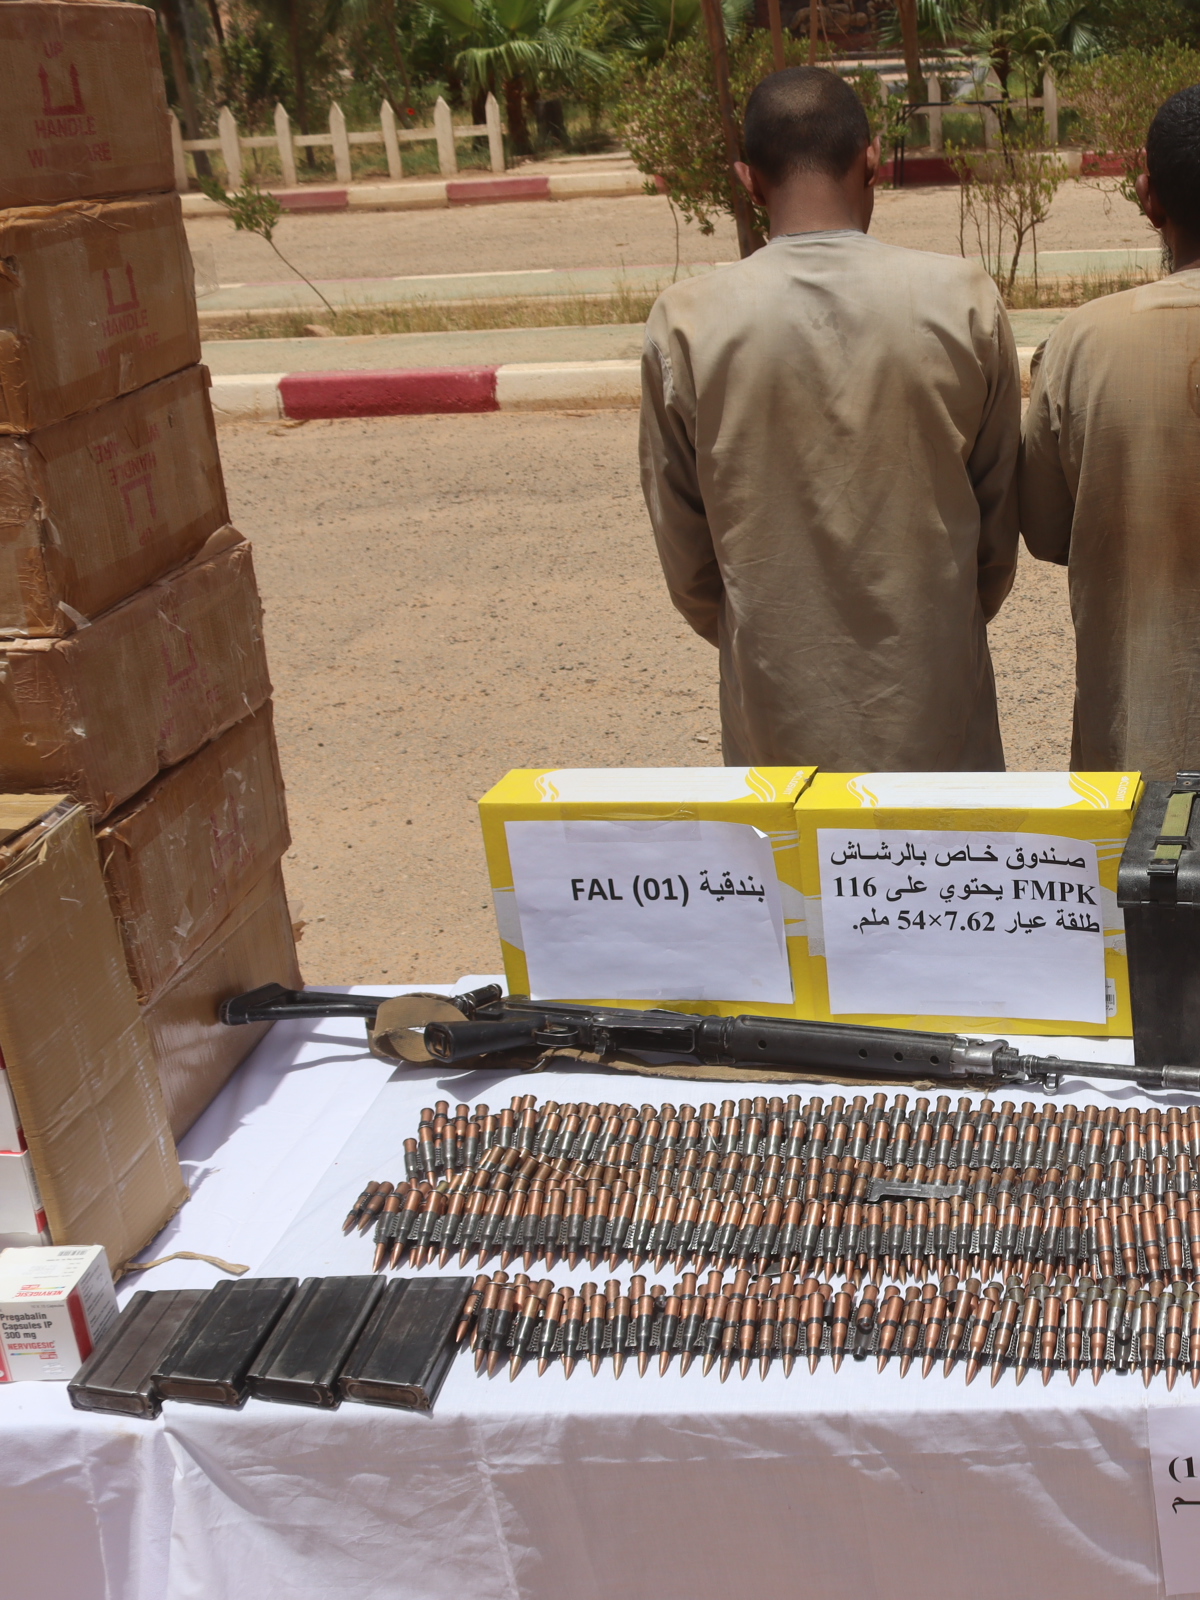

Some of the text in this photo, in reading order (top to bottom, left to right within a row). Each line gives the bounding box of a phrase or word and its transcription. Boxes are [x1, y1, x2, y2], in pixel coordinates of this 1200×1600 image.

[34, 116, 97, 139] HANDLE
[101, 309, 149, 339] HANDLE
[109, 451, 157, 486] HANDLE
[831, 841, 1085, 870] صندوق خاص بالرشاش
[571, 870, 765, 907] بندقية FAL (01)
[835, 876, 1097, 905] FMPK يحتوي على 116
[853, 908, 889, 934] ملم.
[1005, 911, 1046, 933] عيار
[1056, 909, 1100, 932] طلقة
[0, 1312, 47, 1322] Pregabalin
[2, 1322, 42, 1330] Capsules
[4, 1331, 21, 1339] 300
[7, 1341, 55, 1350] NERVIGESIC
